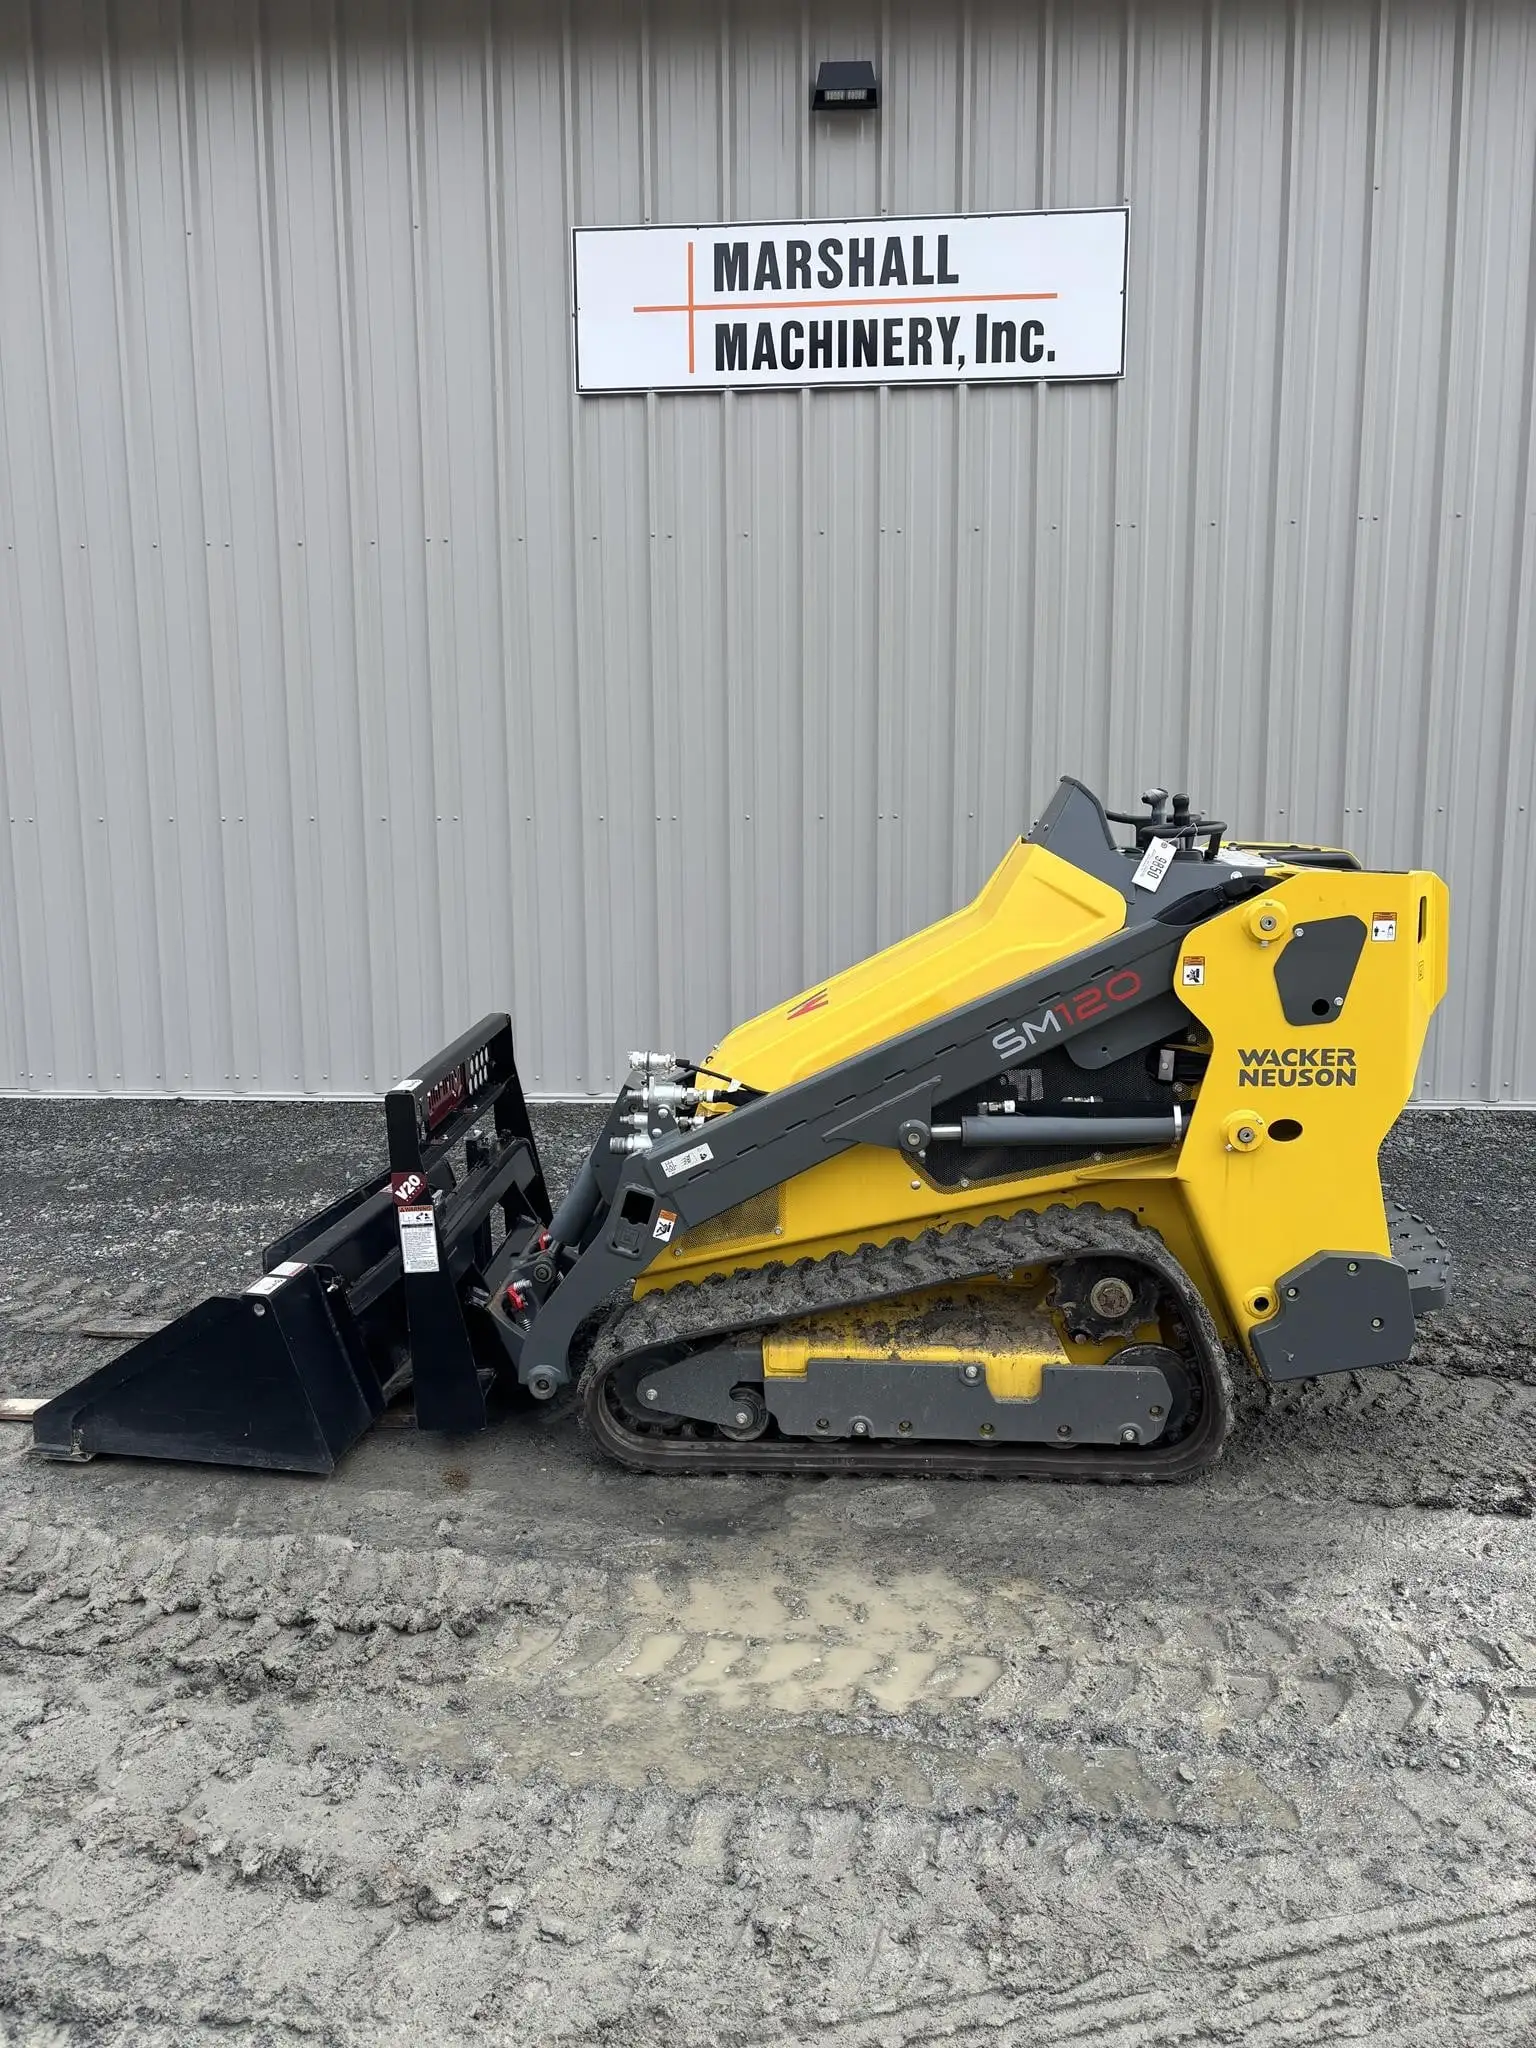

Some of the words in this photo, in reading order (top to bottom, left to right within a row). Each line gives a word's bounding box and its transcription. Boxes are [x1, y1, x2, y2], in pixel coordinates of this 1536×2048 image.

[713, 234, 959, 292] MARSHALL
[715, 315, 965, 371] MACHINERY,
[975, 313, 1056, 364] Inc.
[1147, 855, 1167, 880] 9850
[992, 970, 1142, 1060] SM120
[1237, 1048, 1357, 1067] WACKER
[1239, 1068, 1357, 1087] NEUSON
[394, 1174, 421, 1201] V20
